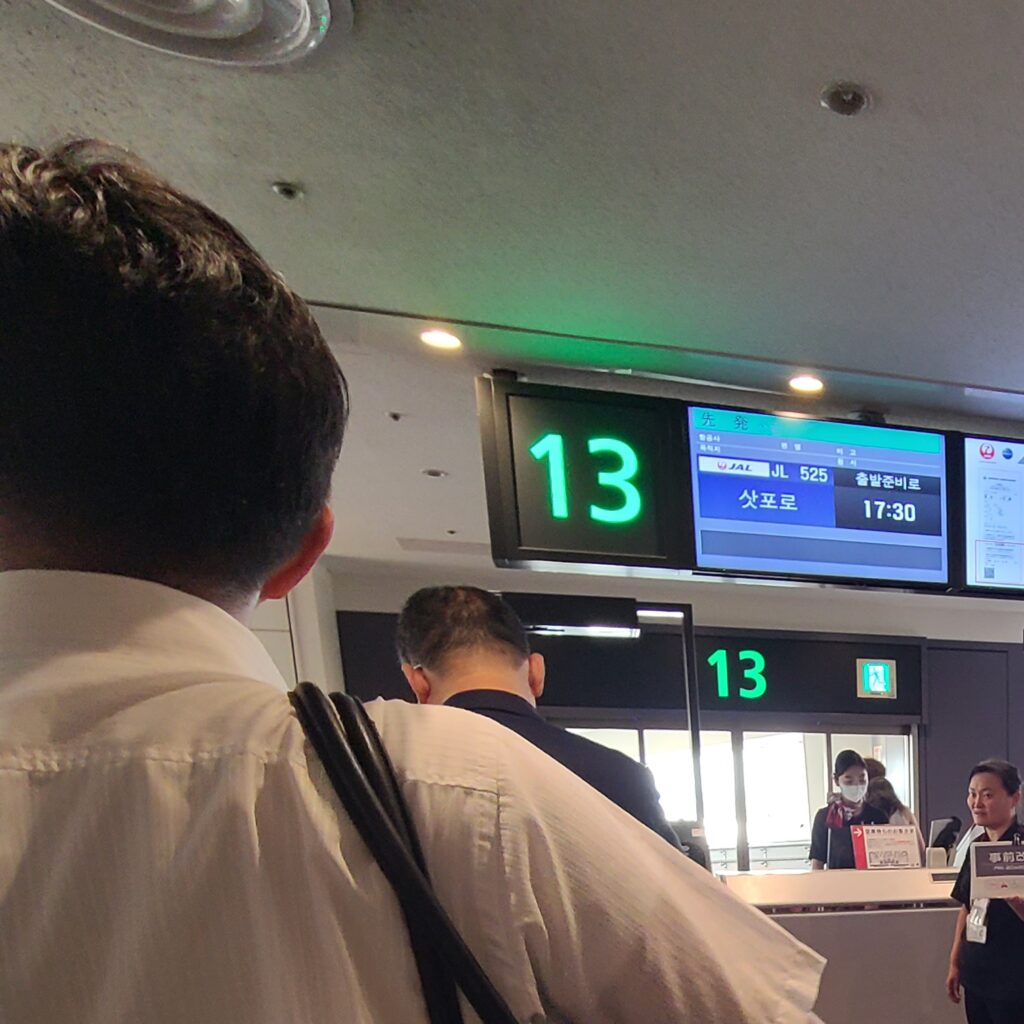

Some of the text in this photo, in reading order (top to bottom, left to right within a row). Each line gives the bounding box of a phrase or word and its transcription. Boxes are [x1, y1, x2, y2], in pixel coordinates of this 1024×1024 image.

[529, 433, 642, 524] 13
[728, 463, 753, 472] JAL
[771, 464, 829, 483] JL 525
[855, 472, 921, 490] 출발준비로
[738, 489, 799, 512] 삿포로
[863, 500, 916, 522] 17:30
[707, 649, 768, 699] 13
